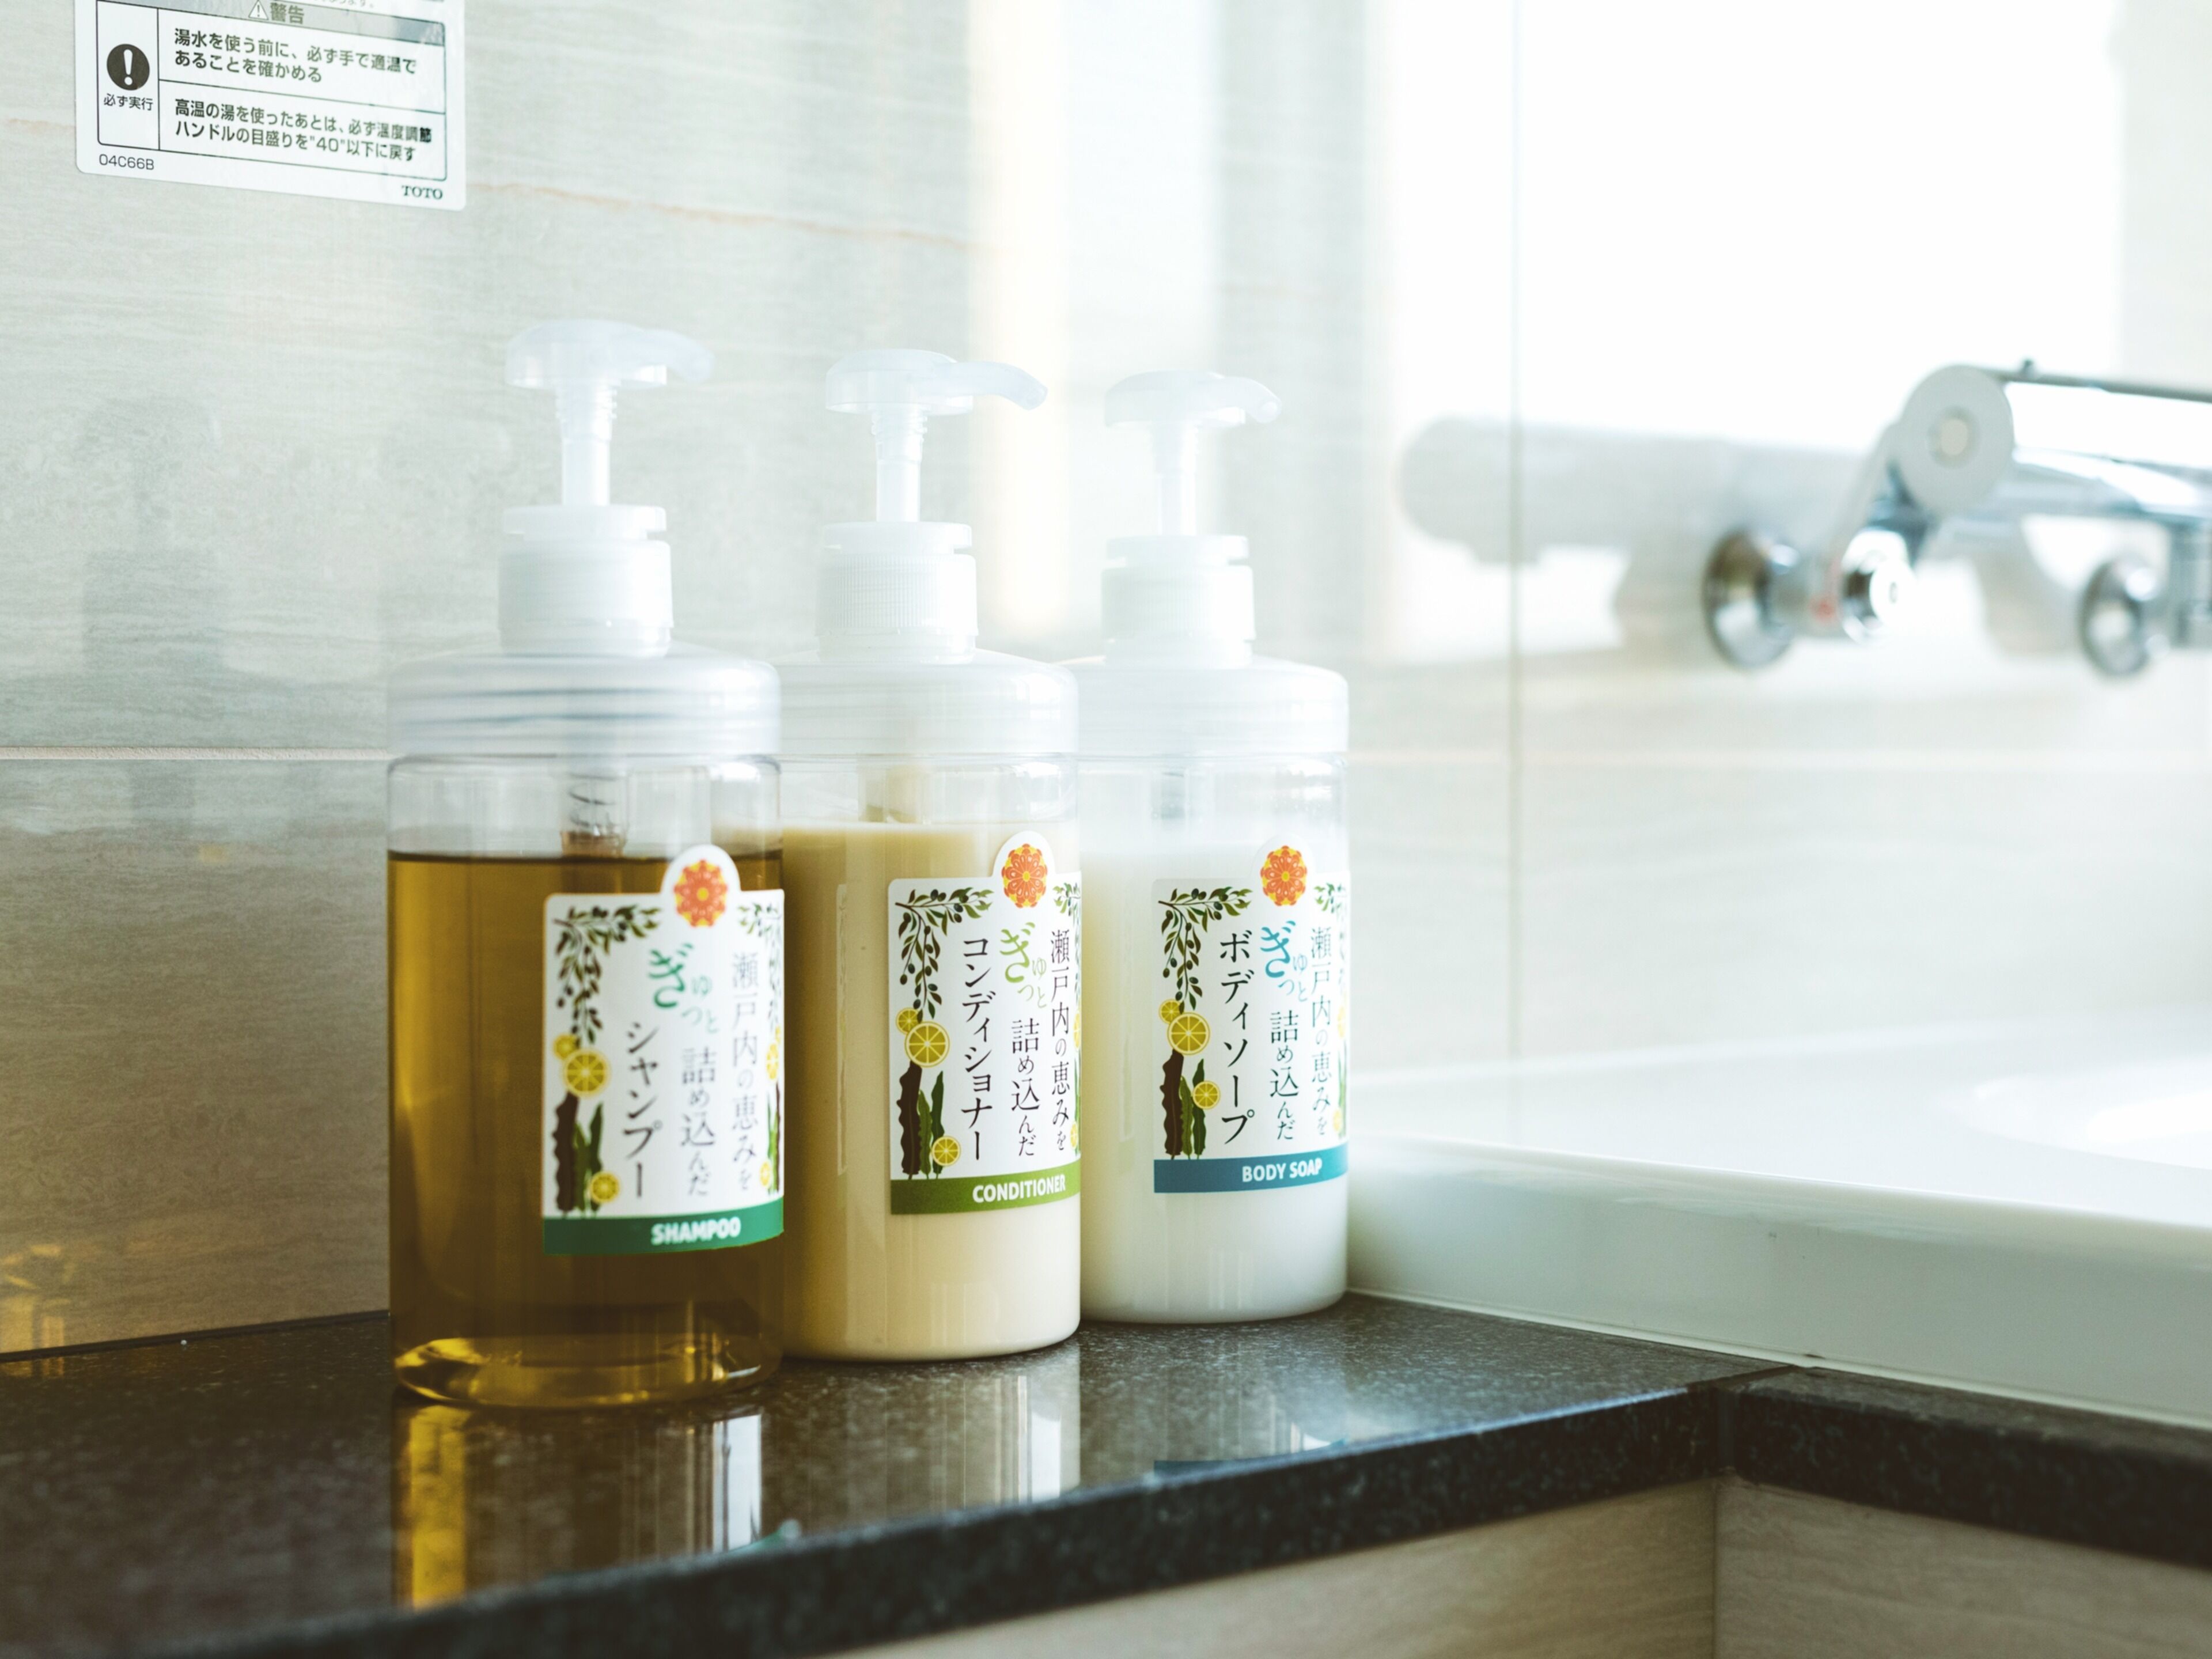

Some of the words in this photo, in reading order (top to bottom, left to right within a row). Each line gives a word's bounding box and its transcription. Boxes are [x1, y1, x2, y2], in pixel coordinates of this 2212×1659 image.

[270, 2, 304, 24] 警告
[175, 28, 416, 74] 湯水を使う前に、必ず手で適温で
[175, 50, 322, 82] あることを確かめる
[104, 93, 153, 111] 必ず実行
[99, 154, 154, 171] 04C66B
[402, 185, 443, 200] TOTO
[1050, 929, 1070, 1152] 瀬戸内の恵みを
[1219, 929, 1255, 1145] ボディソープ
[1310, 926, 1333, 1137] 瀬戸内の恵みを
[961, 937, 996, 1161] コンディショナー
[731, 952, 759, 1191] 瀬戸内の恵みを
[623, 1022, 662, 1199] シャンプー
[1242, 1164, 1286, 1183] BODY
[1289, 1157, 1323, 1179] SOAP
[972, 1173, 1066, 1203] CONDITIONER
[652, 1216, 741, 1246] SHAMPOO
